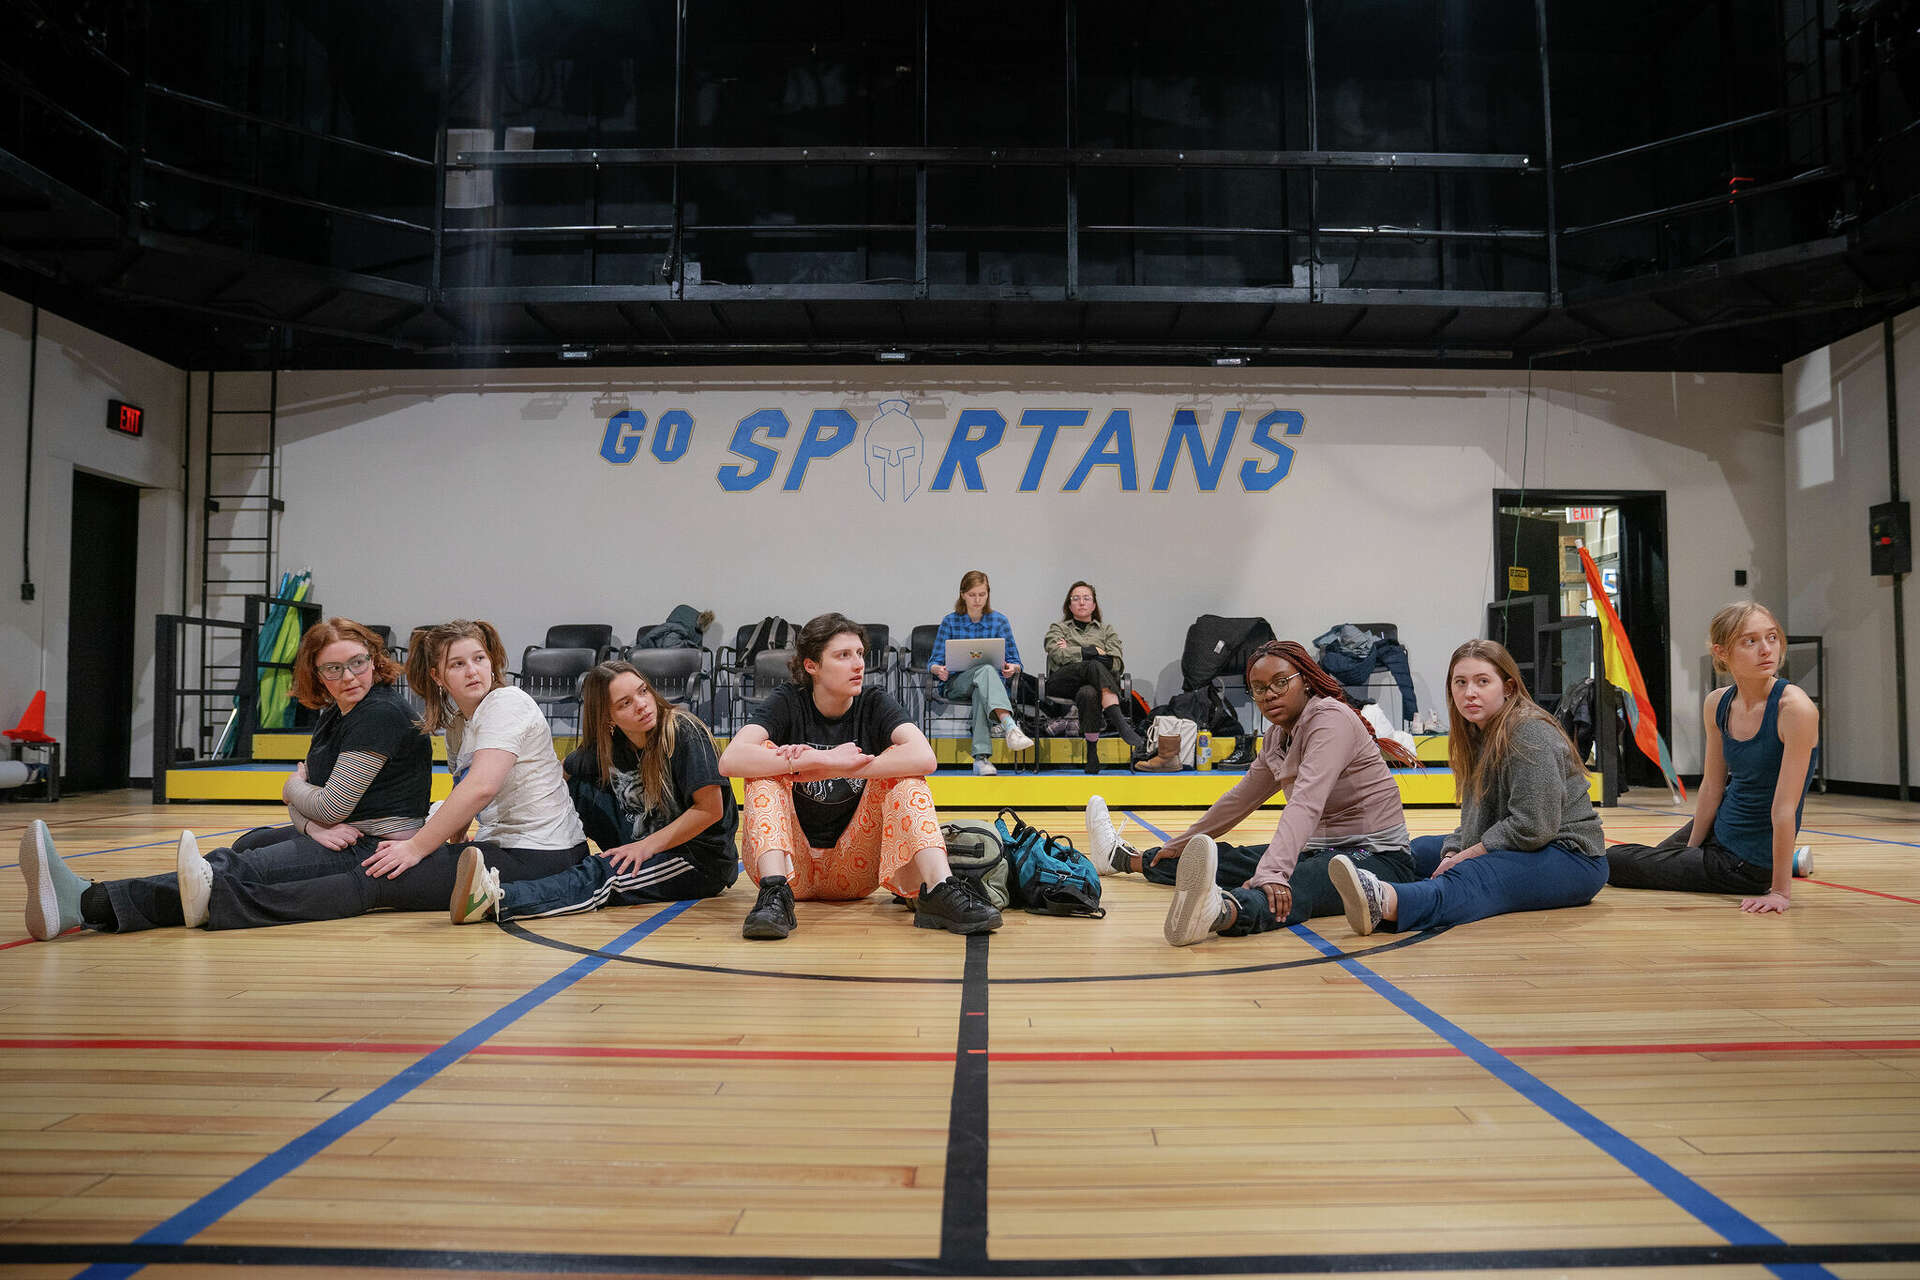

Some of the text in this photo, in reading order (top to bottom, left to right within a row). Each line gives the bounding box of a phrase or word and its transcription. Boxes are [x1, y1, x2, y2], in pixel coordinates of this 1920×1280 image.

[120, 405, 142, 433] EXIT
[600, 407, 1307, 493] GO SPRTANS
